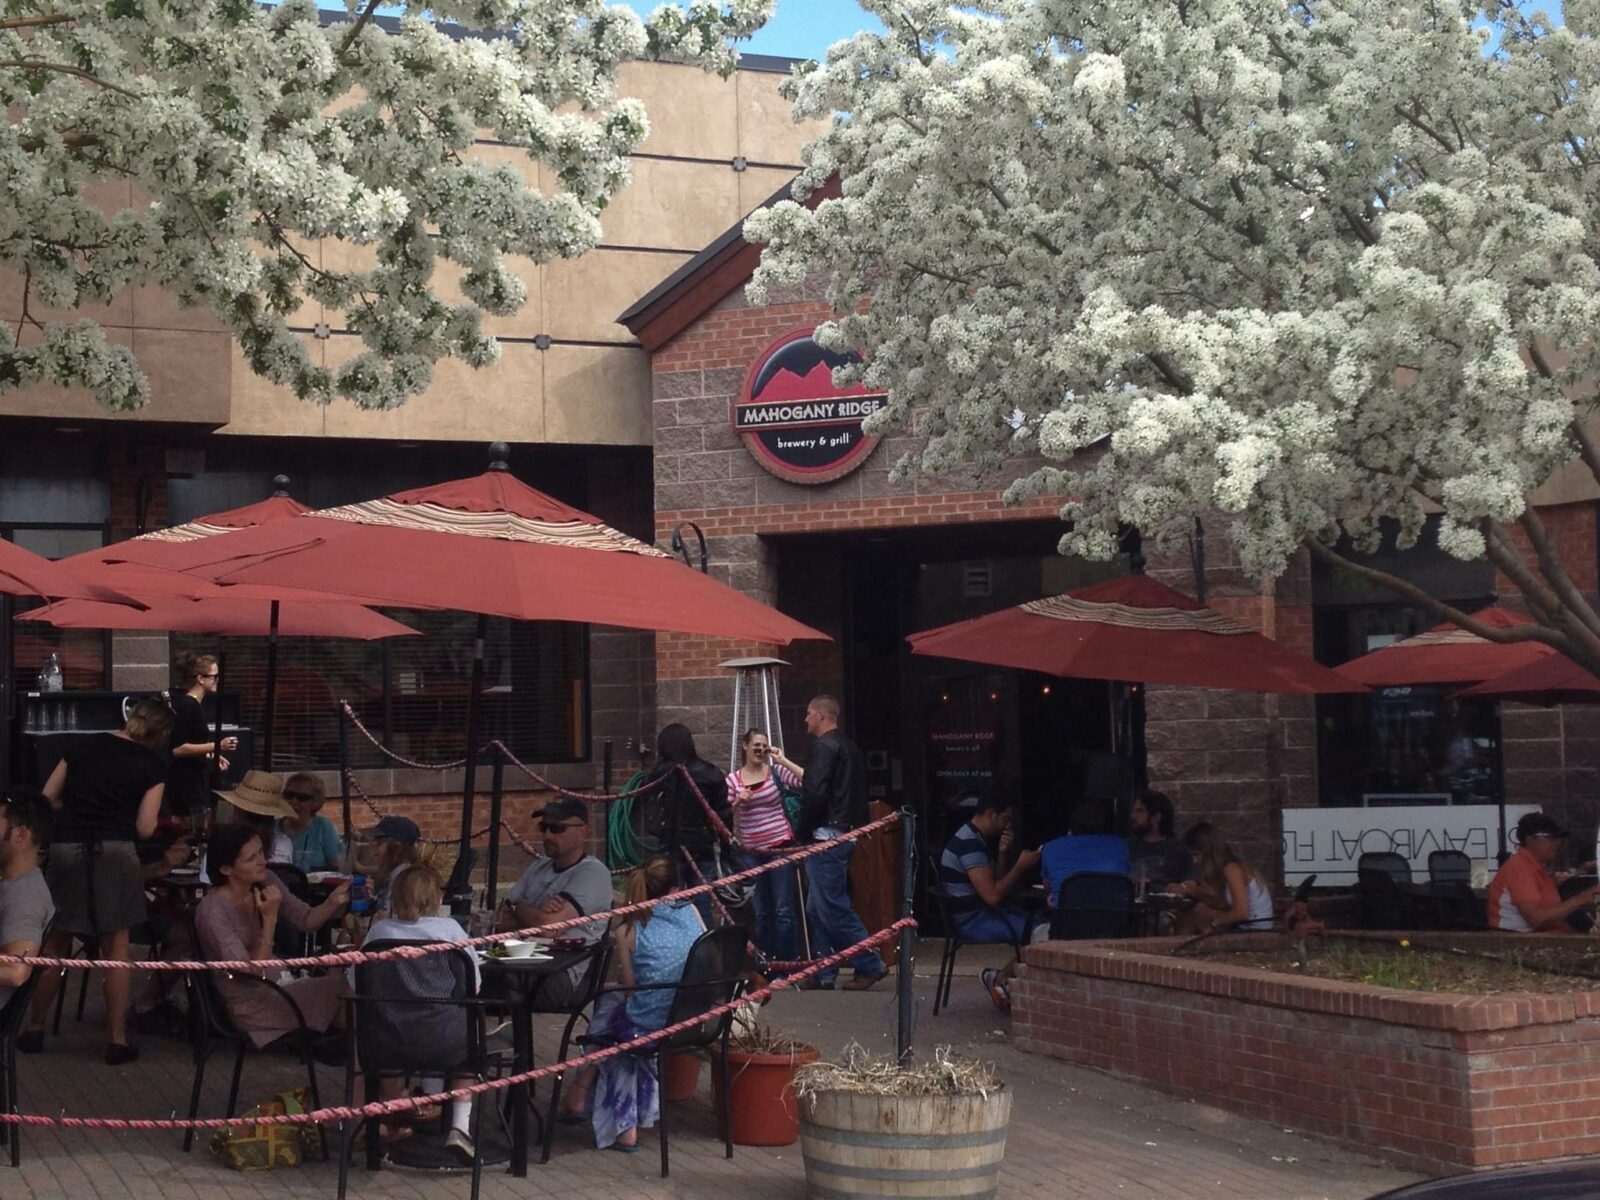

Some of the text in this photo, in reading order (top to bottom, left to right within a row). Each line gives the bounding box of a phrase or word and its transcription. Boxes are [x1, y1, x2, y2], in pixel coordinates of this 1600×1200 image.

[744, 400, 880, 423] MAHOGANY RIDGE
[777, 432, 850, 449] brewery & grill
[1282, 830, 1314, 862] FL
